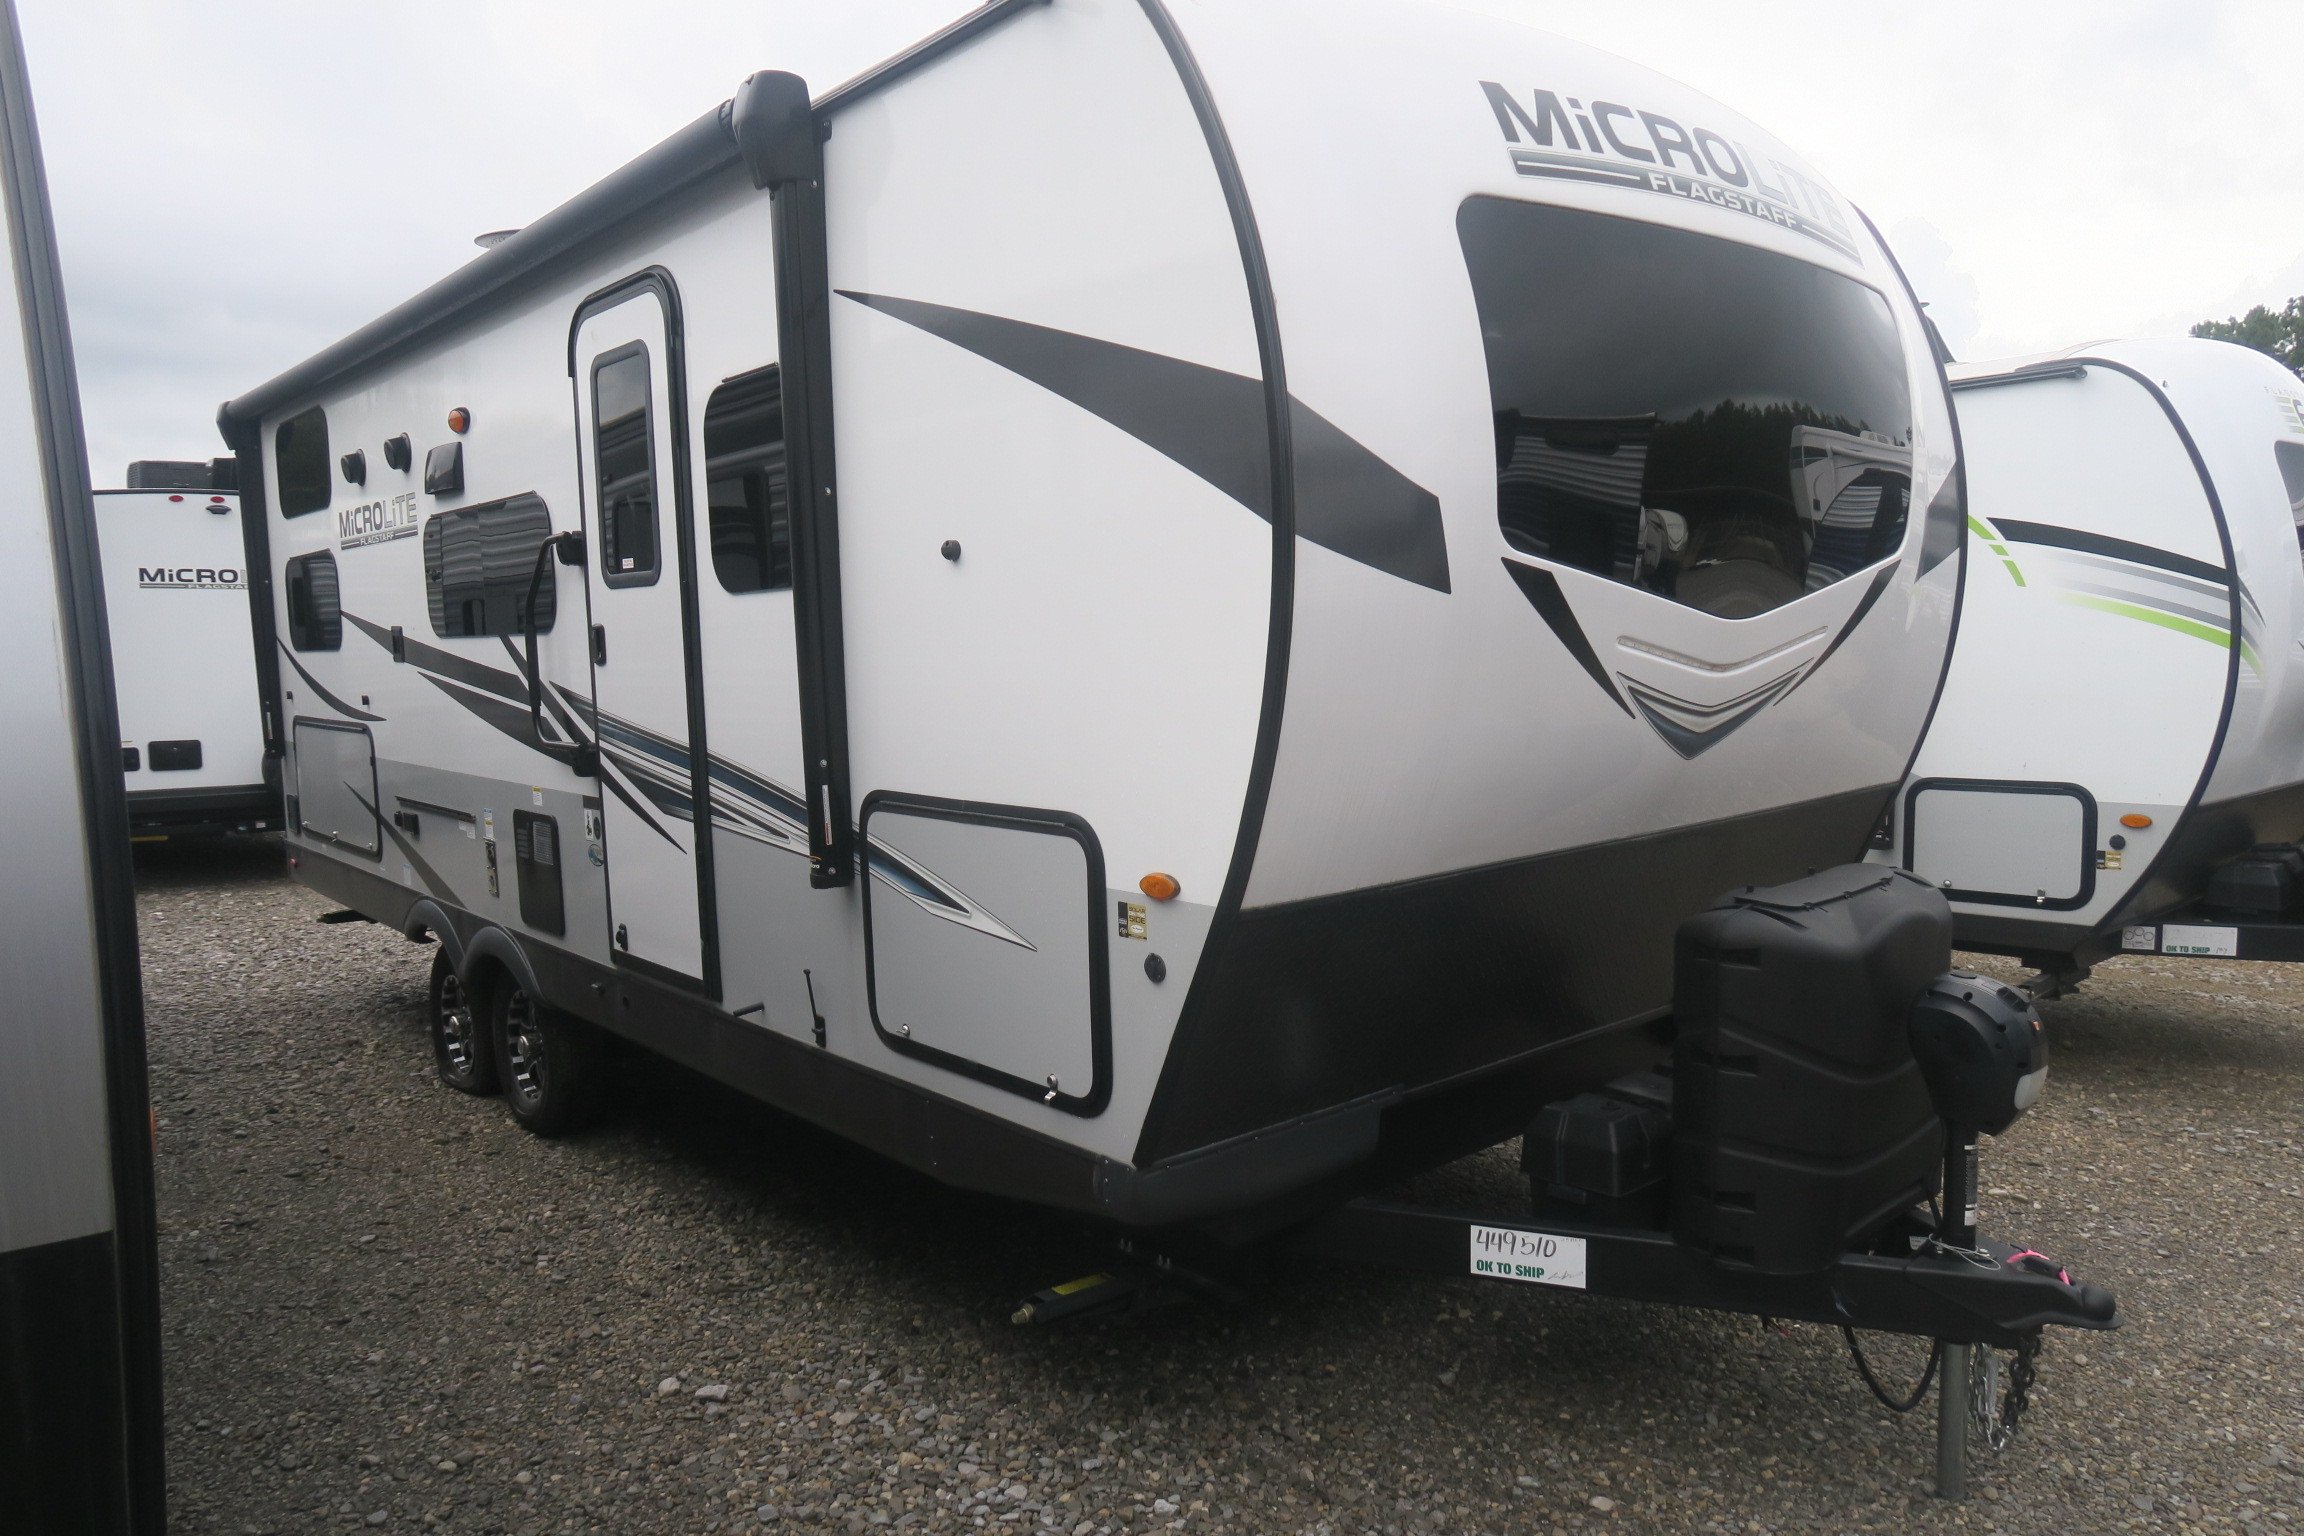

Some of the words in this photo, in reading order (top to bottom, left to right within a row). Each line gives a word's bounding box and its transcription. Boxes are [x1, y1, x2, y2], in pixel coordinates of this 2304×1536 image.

[1648, 171, 1798, 228] FLAGSTAFF
[2165, 945, 2178, 953] OK
[2179, 945, 2190, 953] TO
[2191, 946, 2211, 954] SHIP
[1476, 1259, 1494, 1273] OK
[1496, 1261, 1512, 1275] TO
[1515, 1264, 1545, 1279] SHIP
